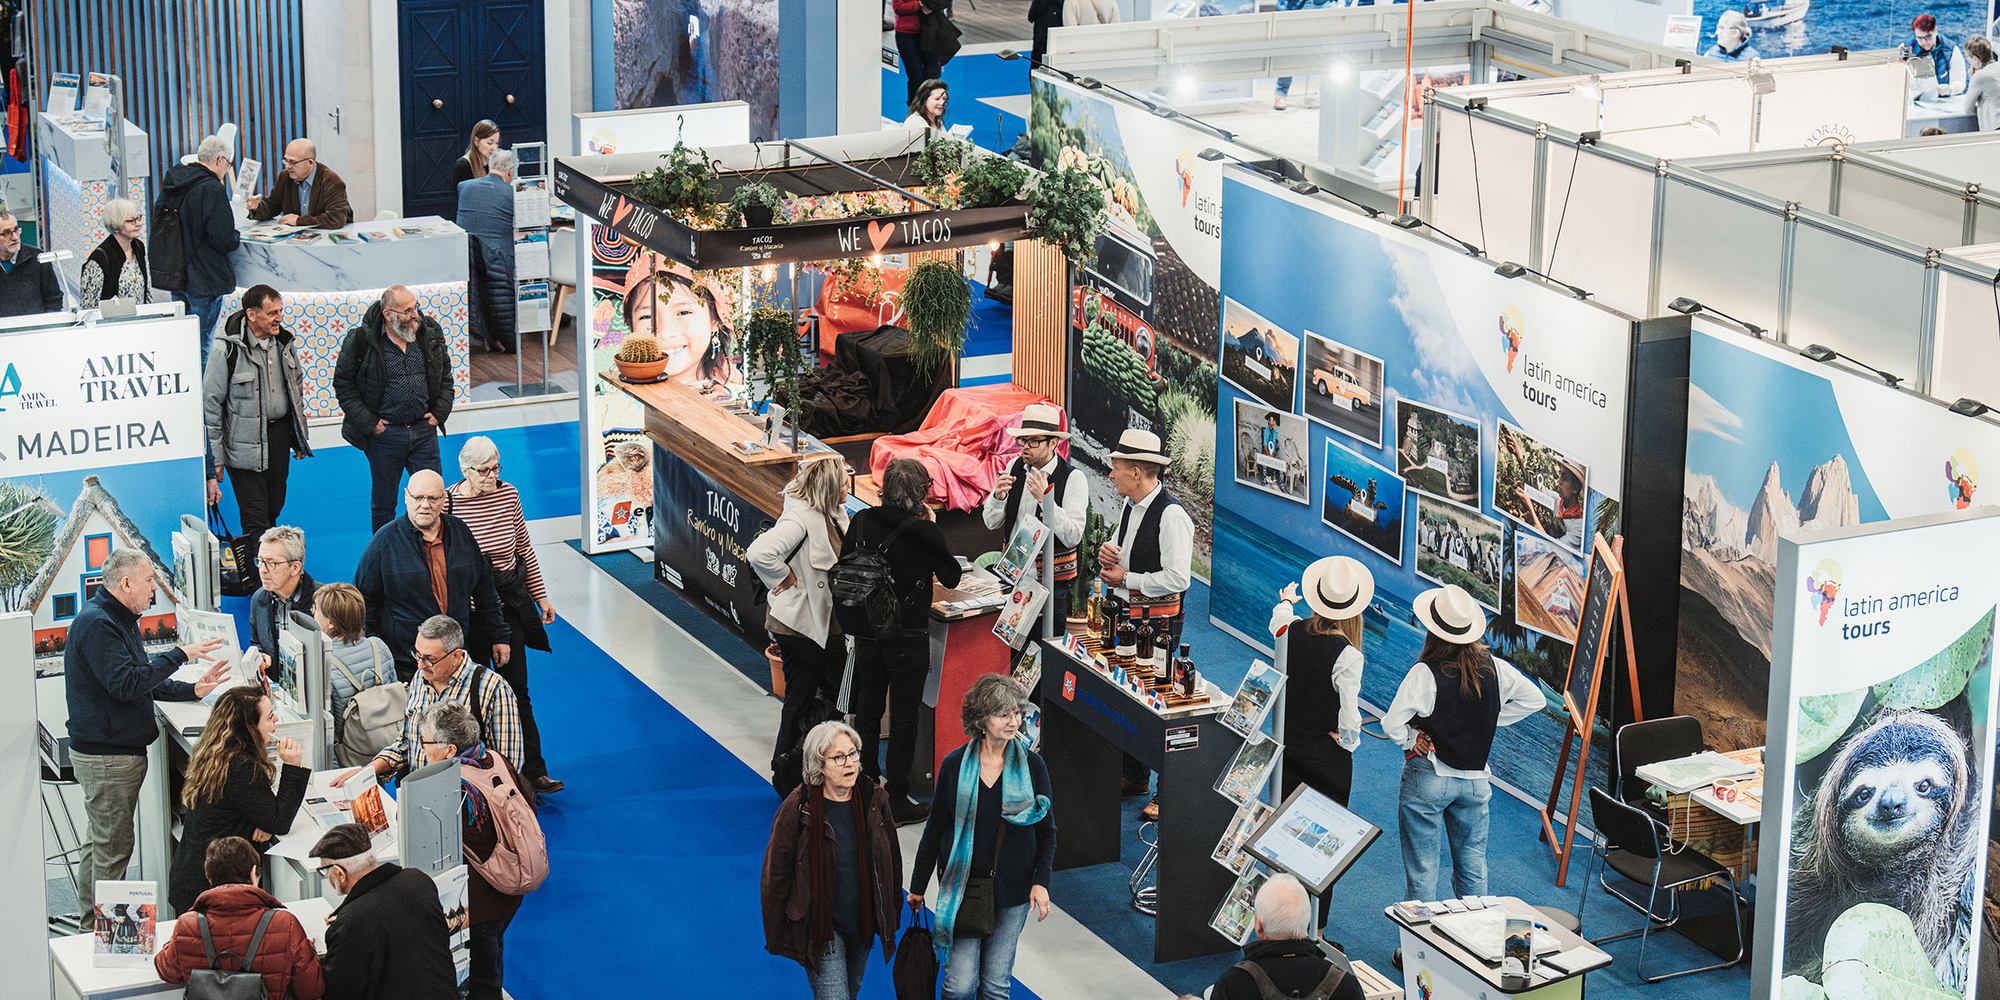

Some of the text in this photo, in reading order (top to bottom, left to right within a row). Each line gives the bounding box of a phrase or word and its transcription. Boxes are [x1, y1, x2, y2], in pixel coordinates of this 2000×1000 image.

[598, 192, 659, 240] WE TACOS
[1194, 191, 1216, 216] latin
[752, 236, 773, 244] TACOS
[838, 217, 951, 252] WE TACOS
[1194, 215, 1220, 239] tours
[80, 351, 155, 380] AMIN
[80, 373, 190, 403] TRAVEL
[1523, 354, 1606, 409] latin america
[19, 399, 58, 410] TRAVEL
[21, 391, 46, 402] AMIN
[1522, 381, 1557, 412] tours
[17, 420, 170, 460] MADEIRA
[706, 491, 740, 533] TACOS
[718, 533, 724, 557] y
[1844, 584, 1959, 618] latin america
[1842, 620, 1890, 640] tours
